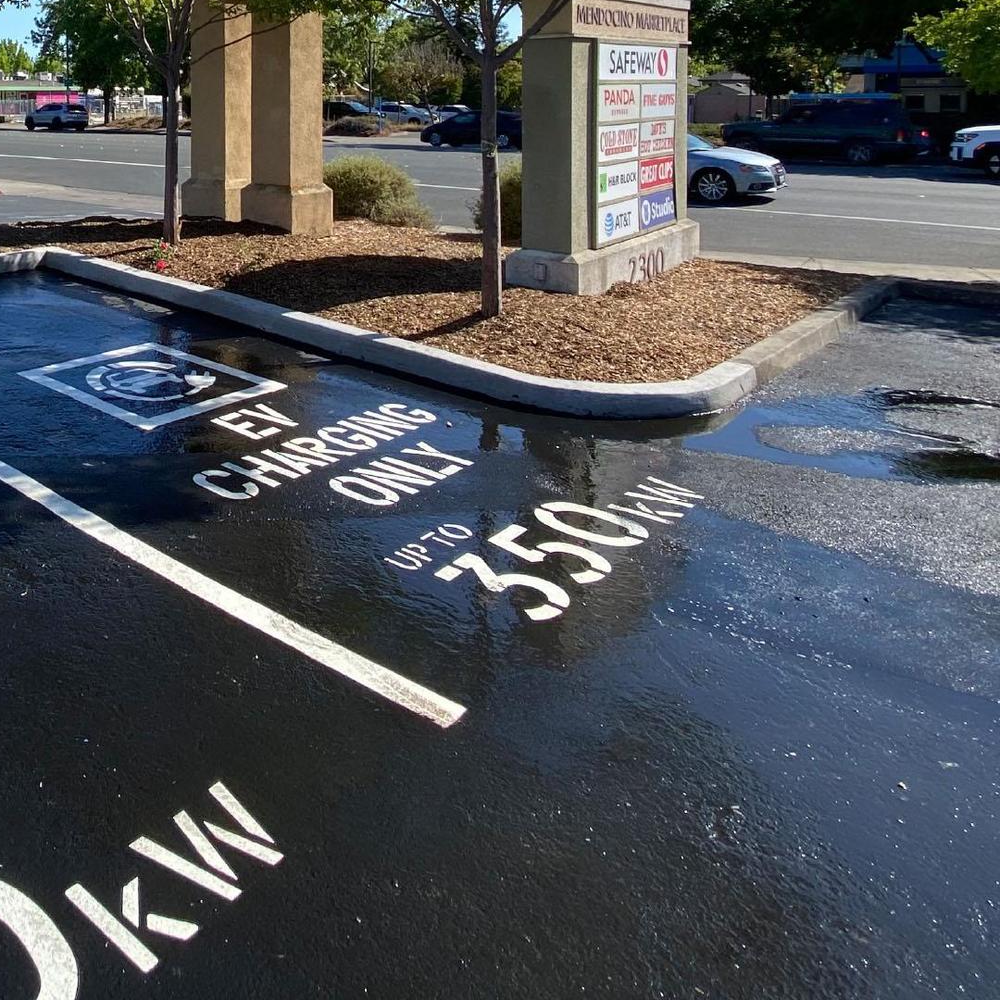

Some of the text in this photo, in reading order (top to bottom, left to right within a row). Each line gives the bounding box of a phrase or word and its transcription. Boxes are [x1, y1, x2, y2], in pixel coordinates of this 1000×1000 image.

[576, 4, 685, 34] MENDOCINO MARKETPLACE
[609, 50, 657, 74] SAFEWAY
[604, 89, 635, 106] PANDA
[620, 172, 636, 184] BLOCK
[615, 211, 632, 231] AT&T
[651, 197, 674, 220] Studio
[629, 247, 664, 282] 2300
[210, 403, 300, 441] EV
[192, 403, 437, 500] CHARGING
[329, 441, 475, 506] ONLY
[384, 523, 473, 571] UP TO
